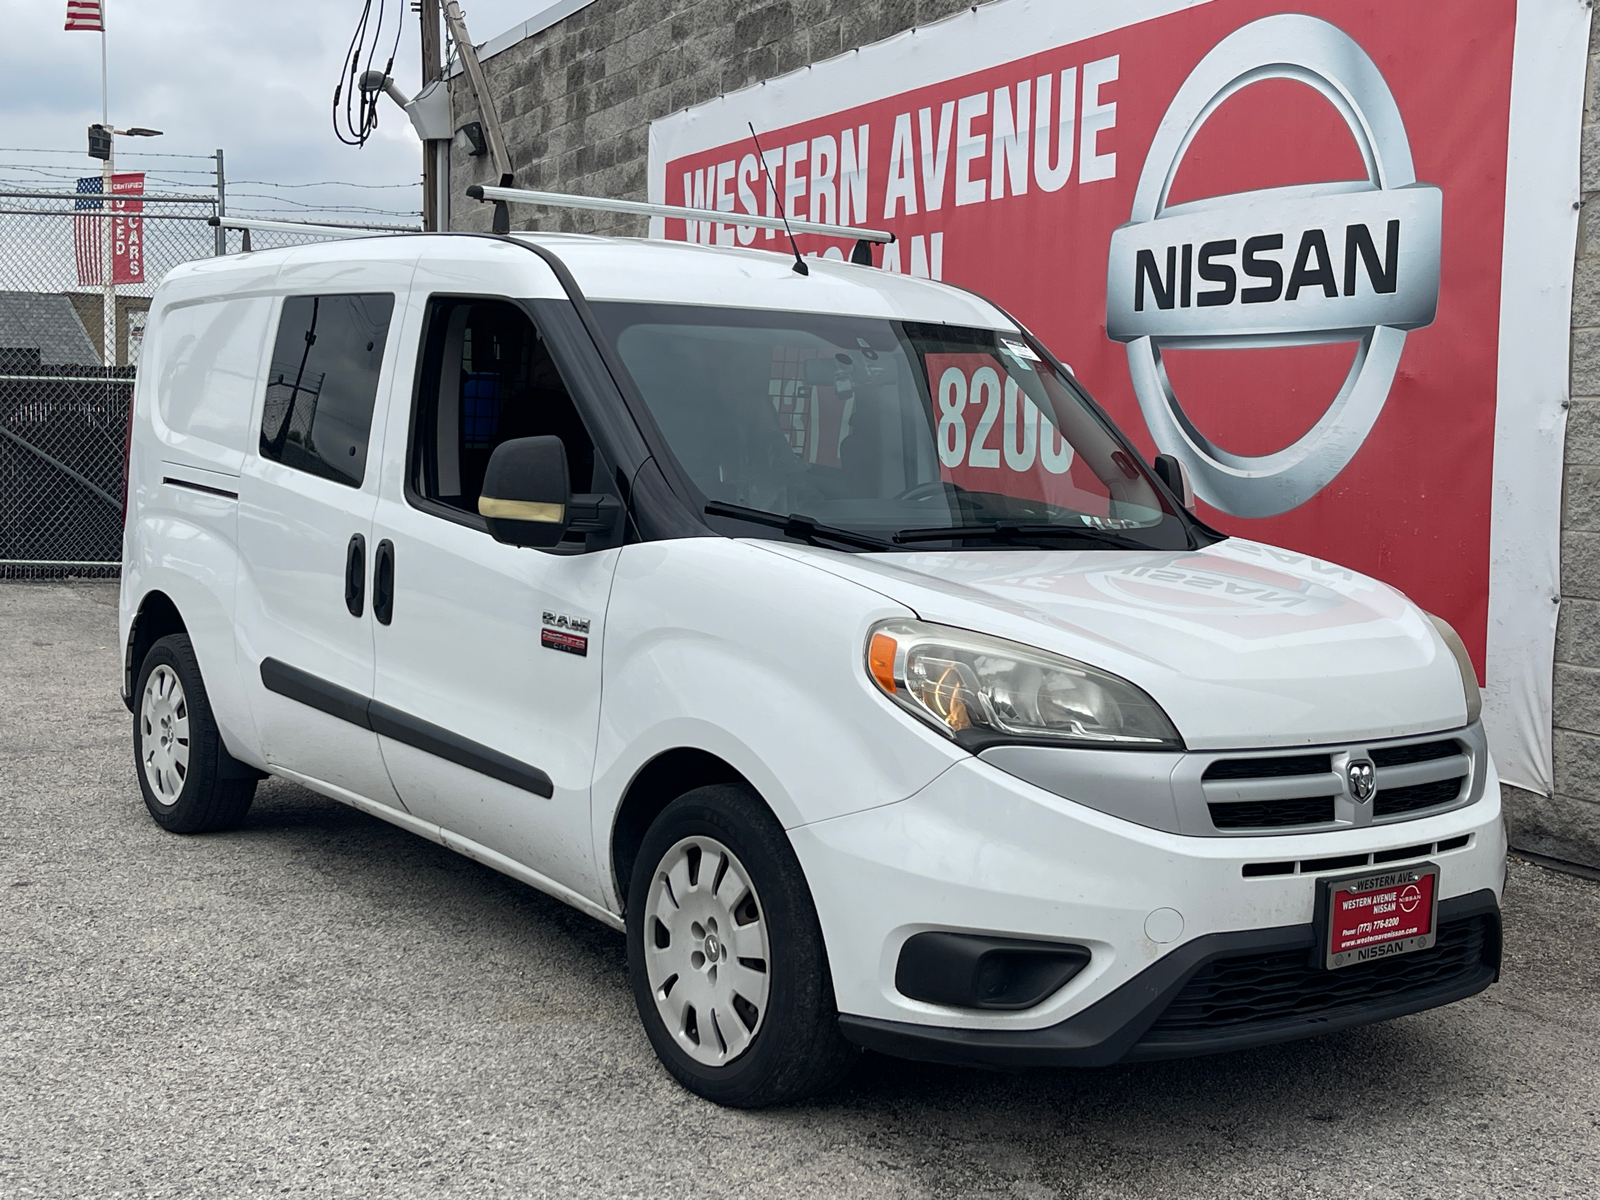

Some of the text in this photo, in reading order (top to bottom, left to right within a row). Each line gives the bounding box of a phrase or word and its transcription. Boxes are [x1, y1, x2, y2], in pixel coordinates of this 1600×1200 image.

[683, 54, 1120, 246] WESTERN AVENUE
[113, 182, 143, 190] CERTIFIED
[116, 200, 125, 255] USED
[128, 217, 139, 275] CARS
[1134, 219, 1400, 312] NISSAN
[542, 610, 591, 633] RAM
[553, 643, 572, 651] CITY
[1357, 875, 1396, 891] WESTERN
[1342, 892, 1398, 911] WESTERN AVENUE
[1399, 894, 1421, 902] NISSAN
[1373, 902, 1396, 915] NISSAN
[1357, 922, 1373, 936] (773)
[1373, 917, 1400, 930] 776-8200
[1358, 941, 1404, 961] NISSAN
